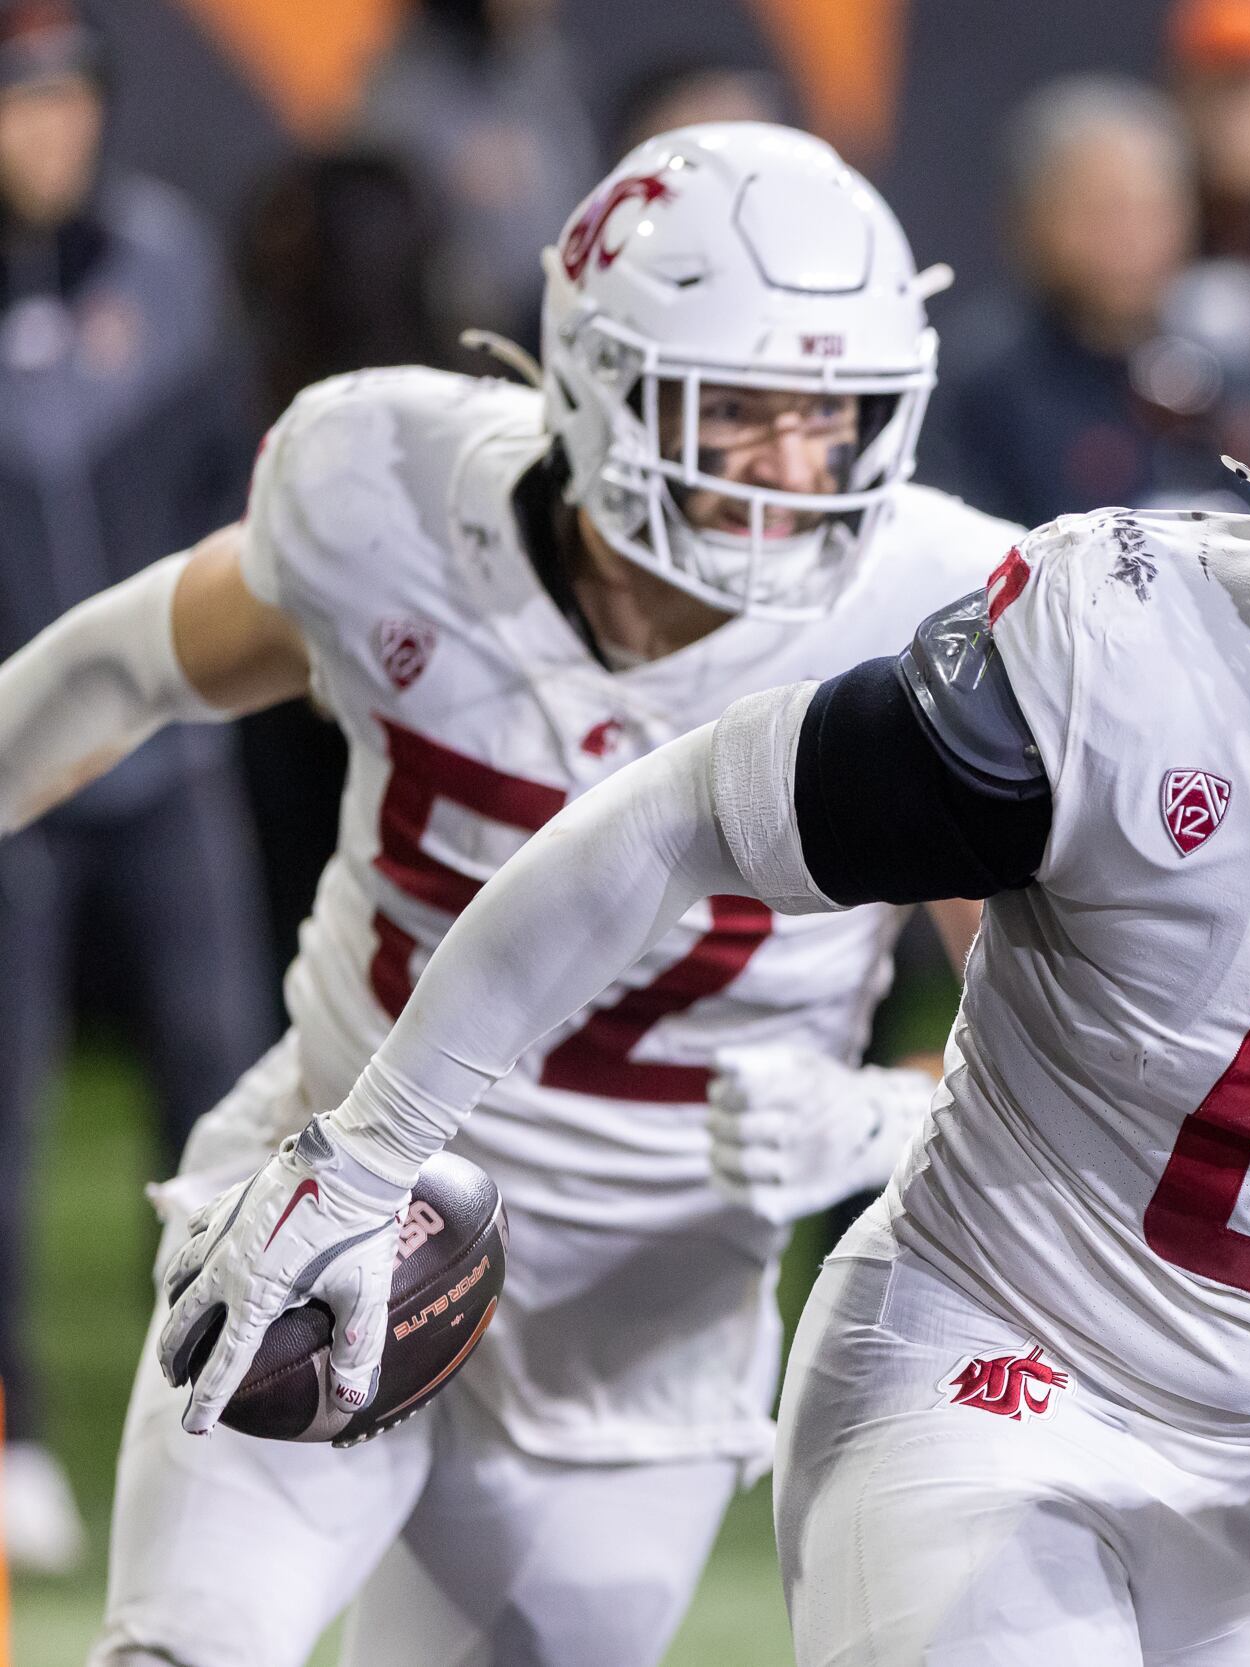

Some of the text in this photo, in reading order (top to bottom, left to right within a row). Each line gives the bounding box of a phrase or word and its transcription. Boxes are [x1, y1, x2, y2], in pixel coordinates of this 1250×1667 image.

[1166, 771, 1229, 827] PAC
[1174, 805, 1209, 838] 12
[391, 1200, 445, 1272] OS
[393, 1255, 490, 1341] VAPOR ELITE
[336, 1384, 366, 1406] WSU
